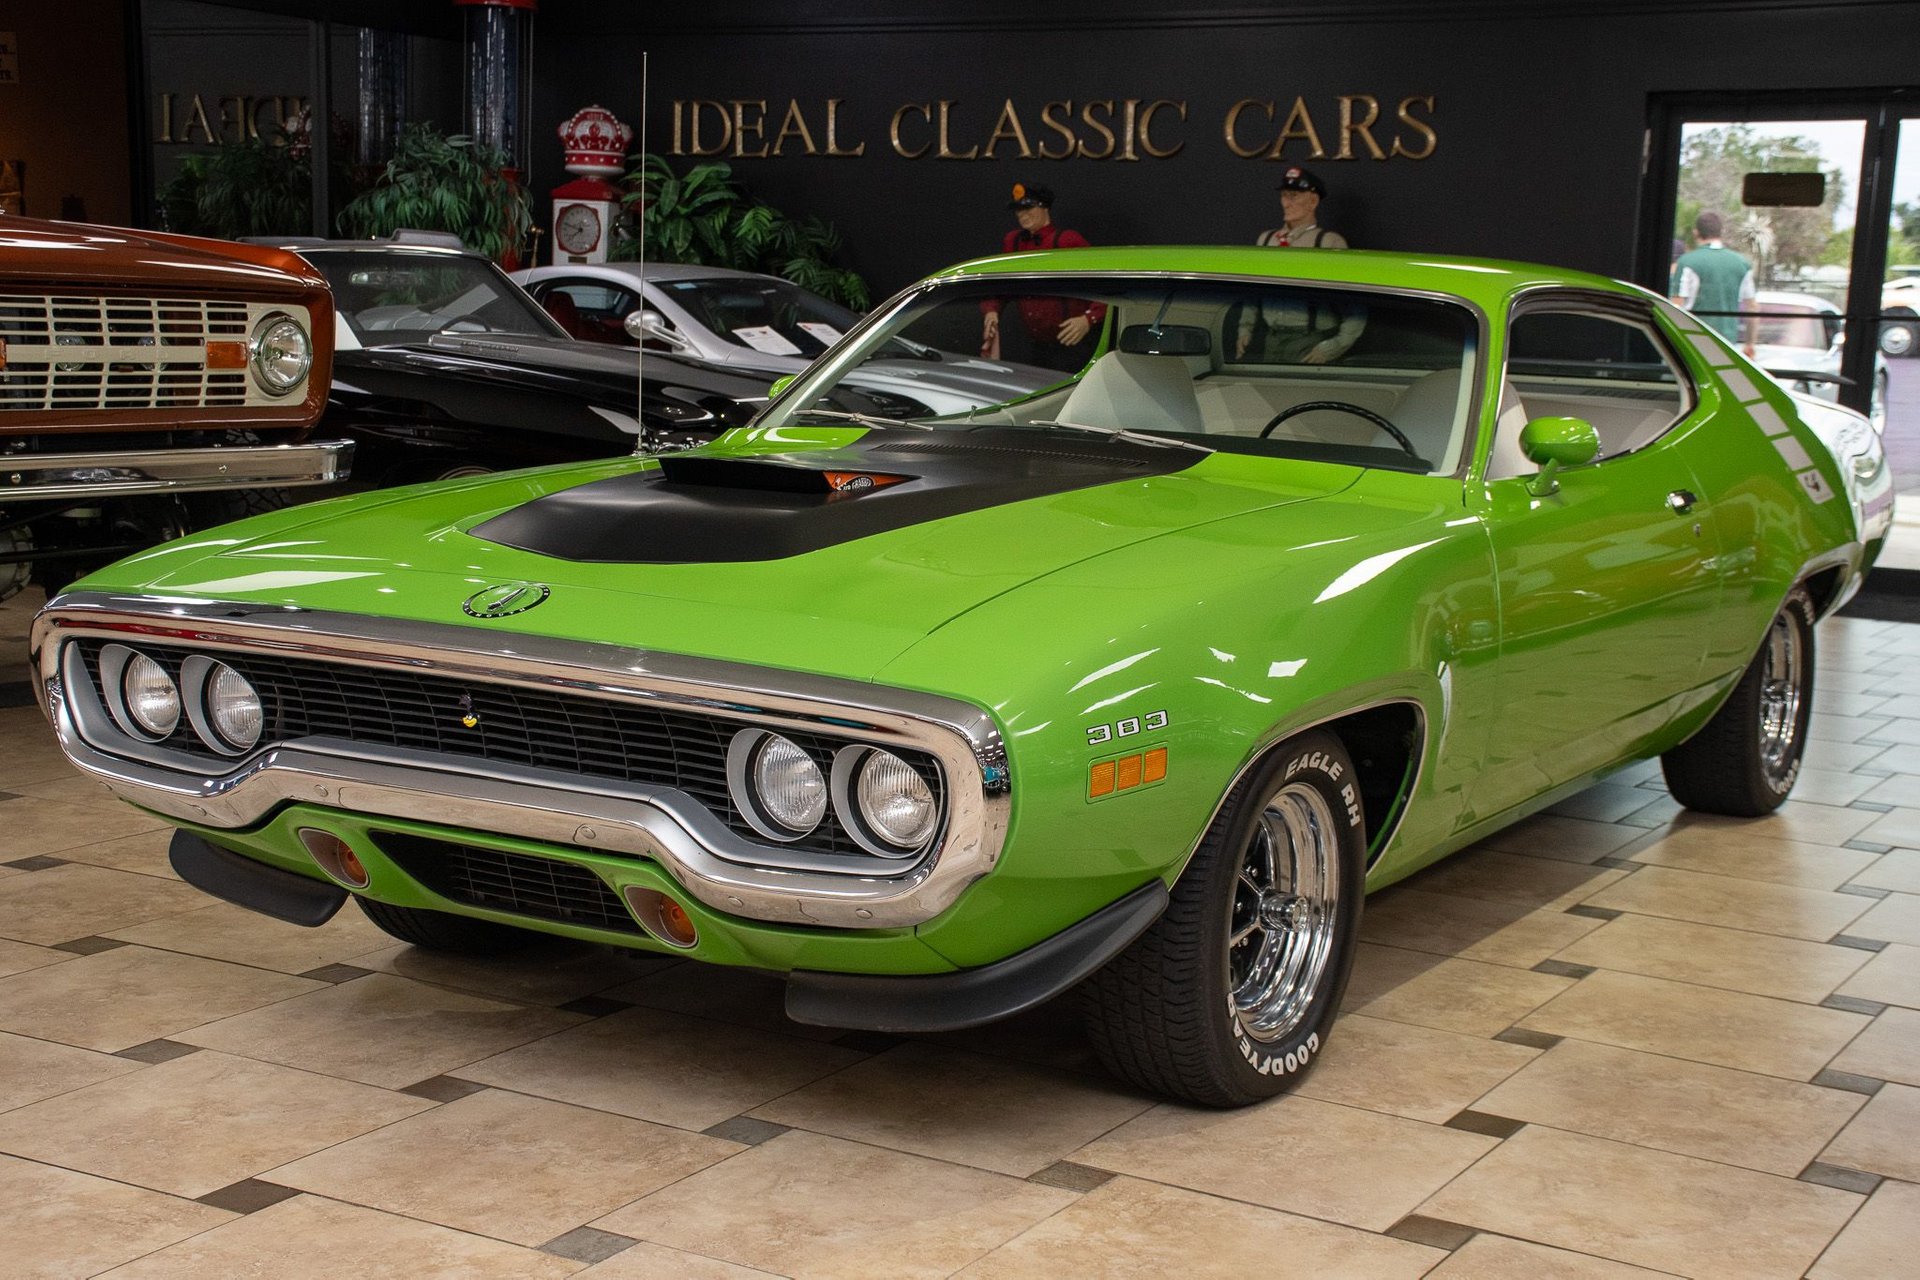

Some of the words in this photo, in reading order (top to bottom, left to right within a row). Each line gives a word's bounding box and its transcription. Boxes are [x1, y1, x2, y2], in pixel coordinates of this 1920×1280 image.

[671, 98, 866, 158] IDEAL
[889, 97, 1188, 161] CLASSIC
[1224, 94, 1438, 161] CARS
[1086, 710, 1169, 745] 383
[1285, 751, 1344, 782] EAGLE
[1341, 783, 1361, 827] RH
